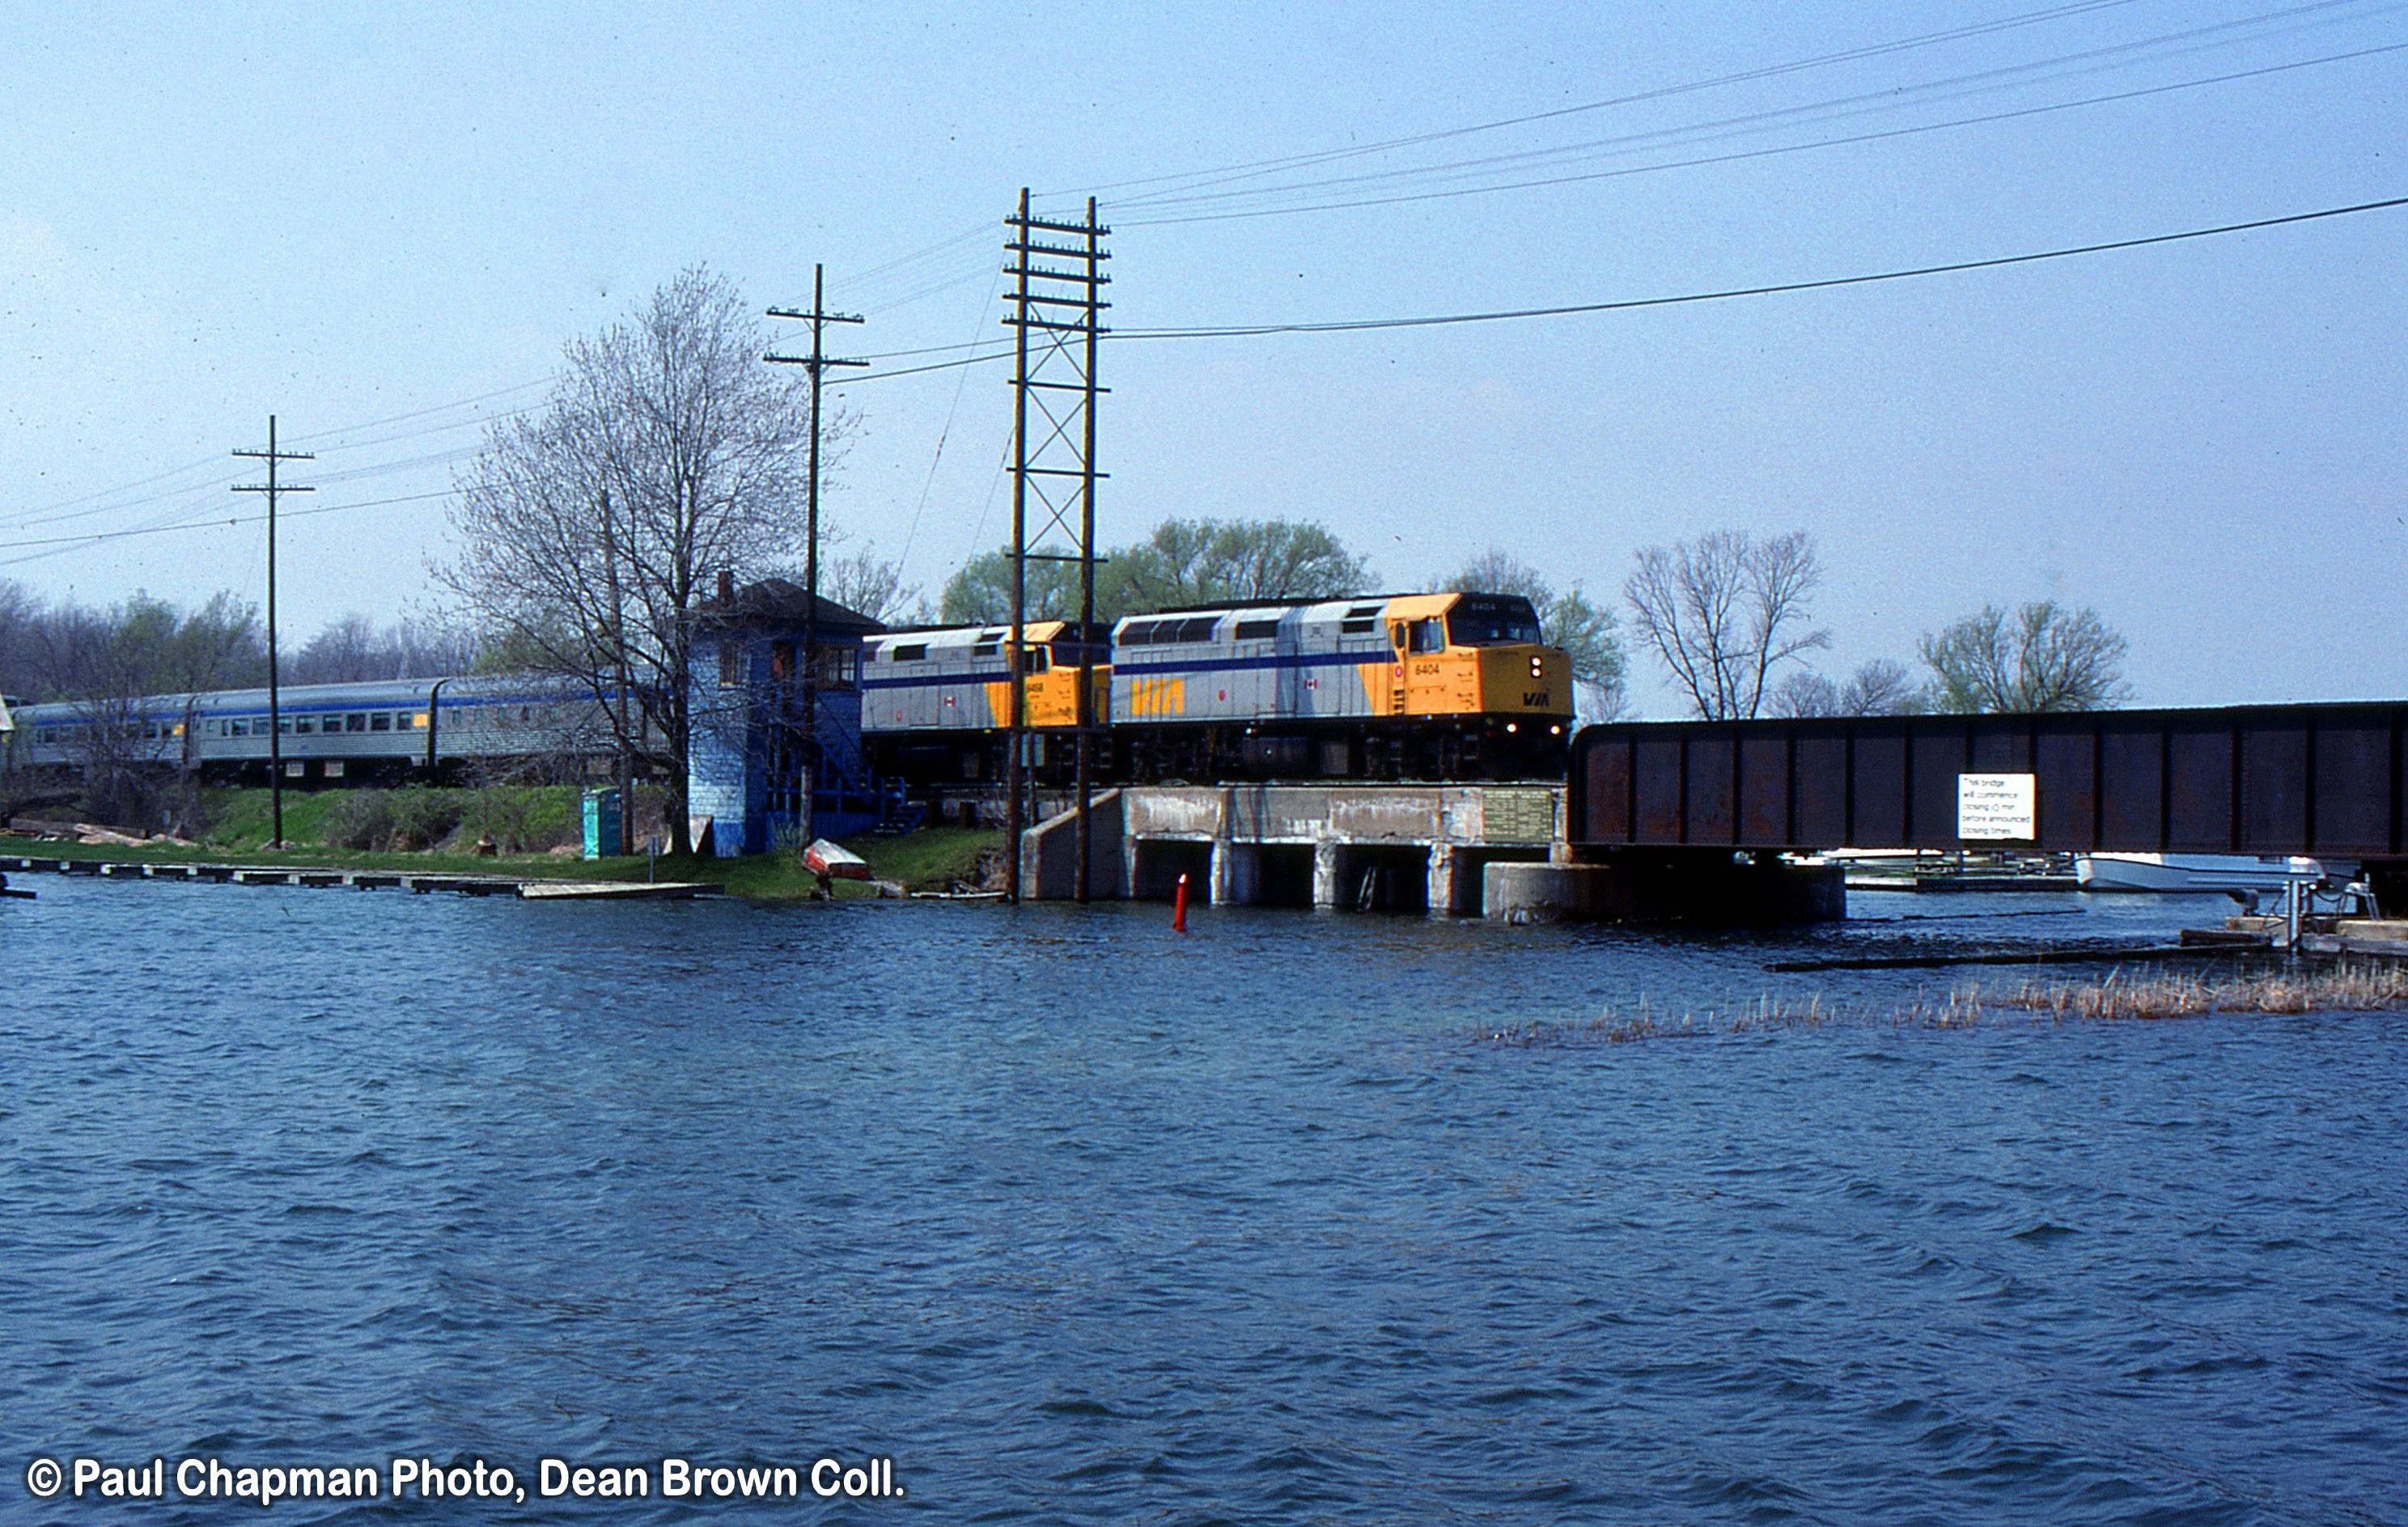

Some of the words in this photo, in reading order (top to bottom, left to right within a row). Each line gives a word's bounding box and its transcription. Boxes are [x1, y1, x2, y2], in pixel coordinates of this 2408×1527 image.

[1415, 664, 1440, 676] 6404
[1131, 678, 1185, 715] VIA
[1523, 692, 1550, 706] VIA
[1963, 778, 1979, 786] This
[1981, 779, 2004, 787] bridge
[1962, 804, 1989, 812] closing
[1989, 815, 2030, 823] announced
[1962, 827, 1989, 835] closing
